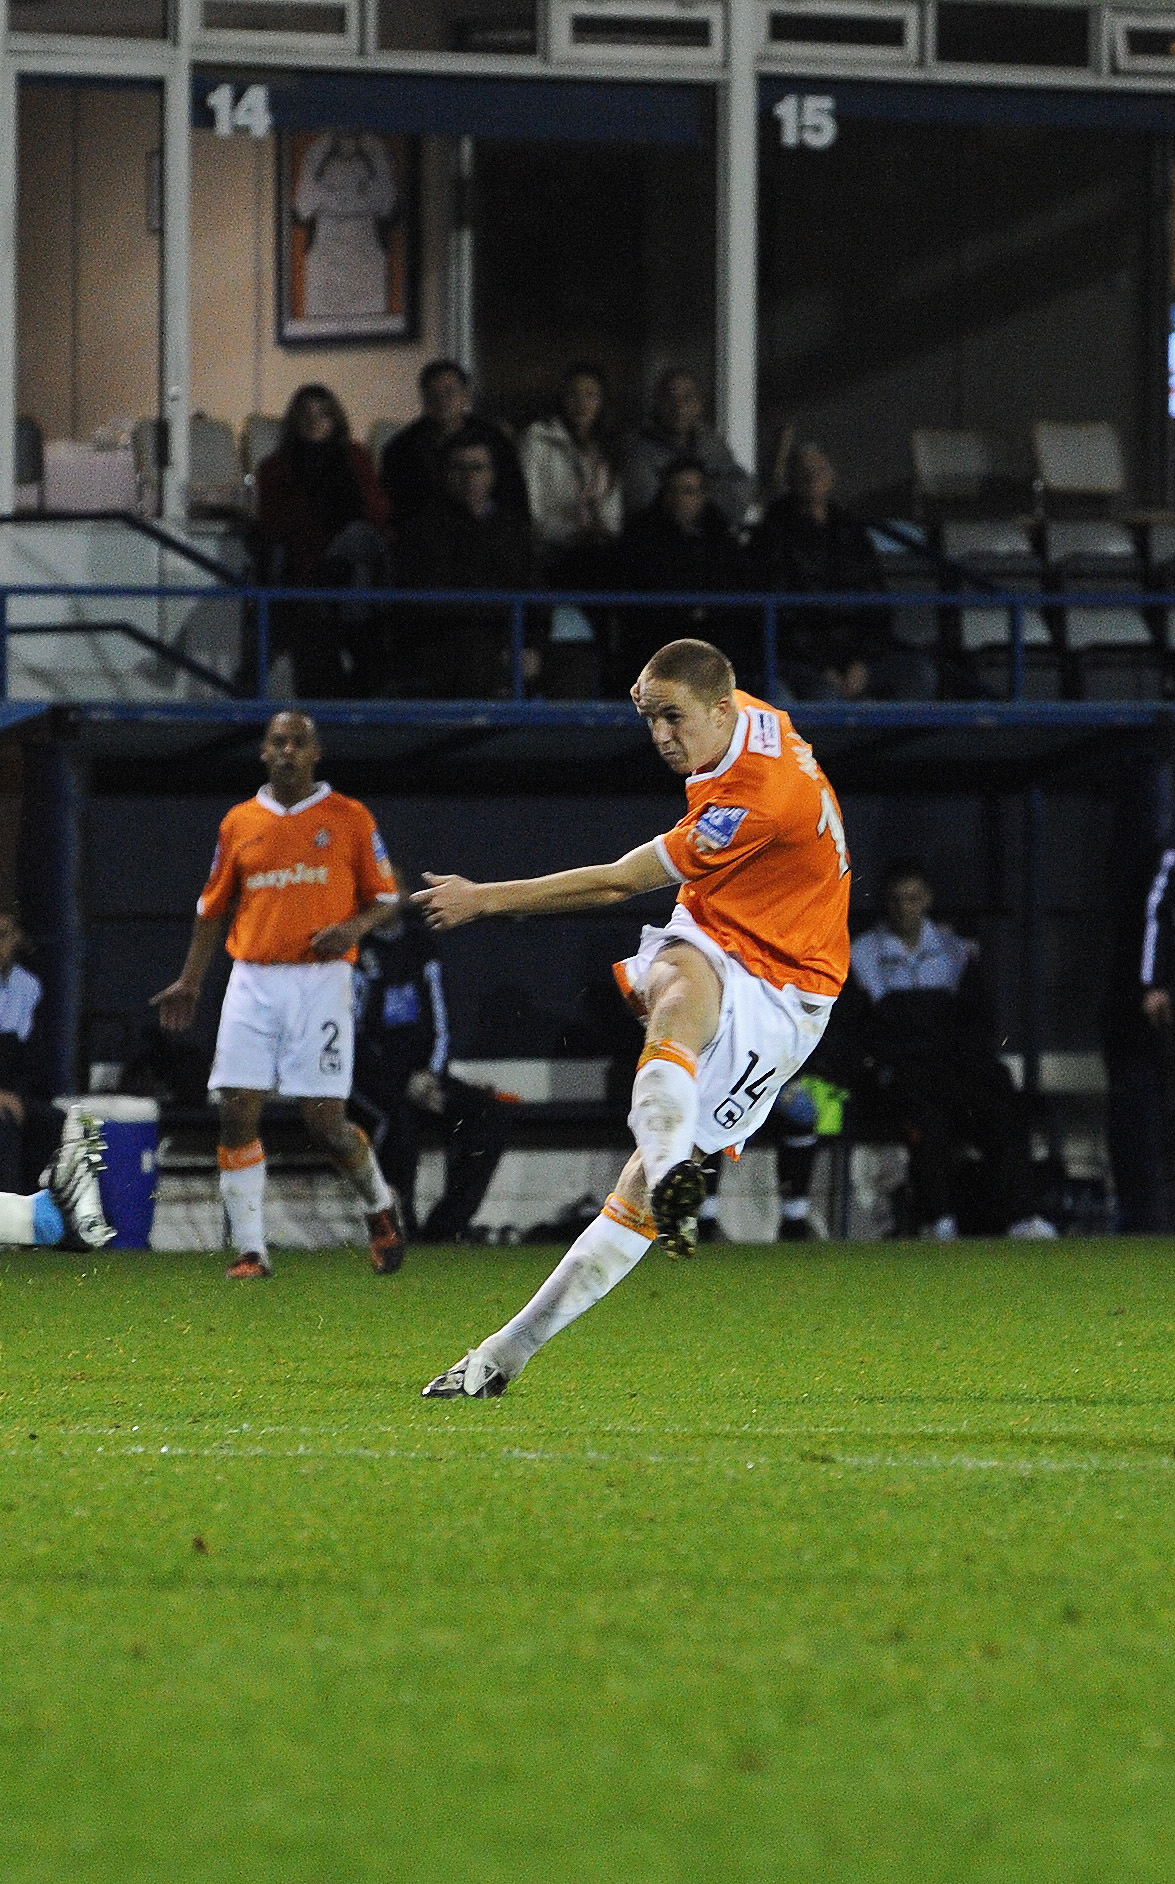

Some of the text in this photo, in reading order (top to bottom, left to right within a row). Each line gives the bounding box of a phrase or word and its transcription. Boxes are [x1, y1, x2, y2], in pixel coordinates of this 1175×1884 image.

[205, 83, 271, 140] 14
[773, 93, 838, 149] 15
[320, 1020, 340, 1055] 2
[728, 1049, 777, 1110] 14
